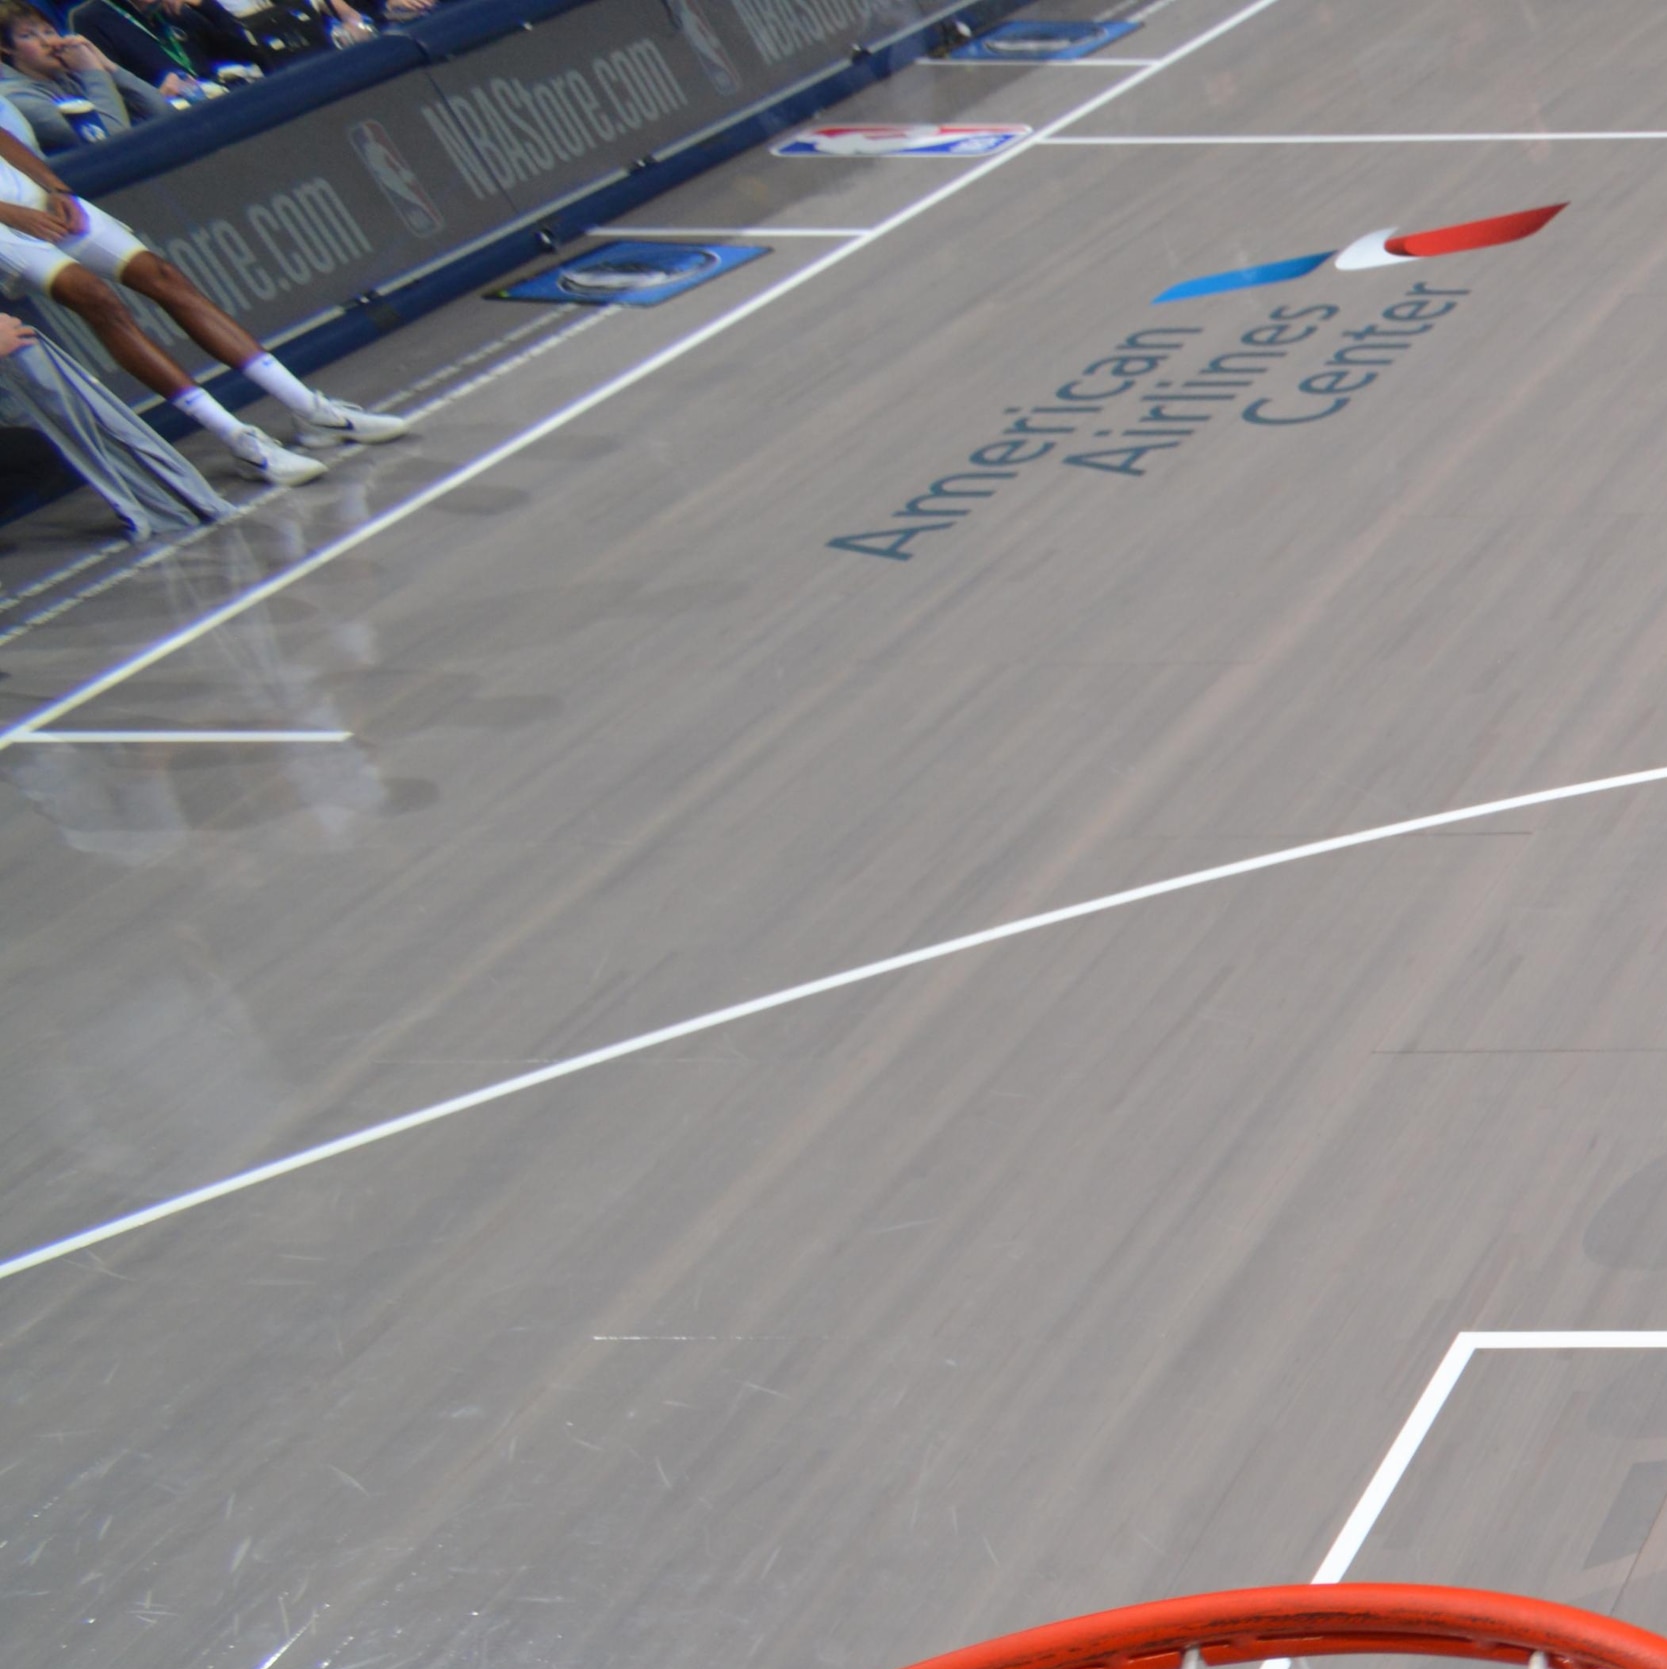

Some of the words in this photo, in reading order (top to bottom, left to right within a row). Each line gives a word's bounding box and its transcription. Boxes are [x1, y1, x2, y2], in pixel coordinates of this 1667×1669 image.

[421, 38, 689, 199] NBAStore.com
[1062, 304, 1340, 477] Airlines
[1242, 281, 1471, 425] Center
[824, 326, 1204, 562] American
